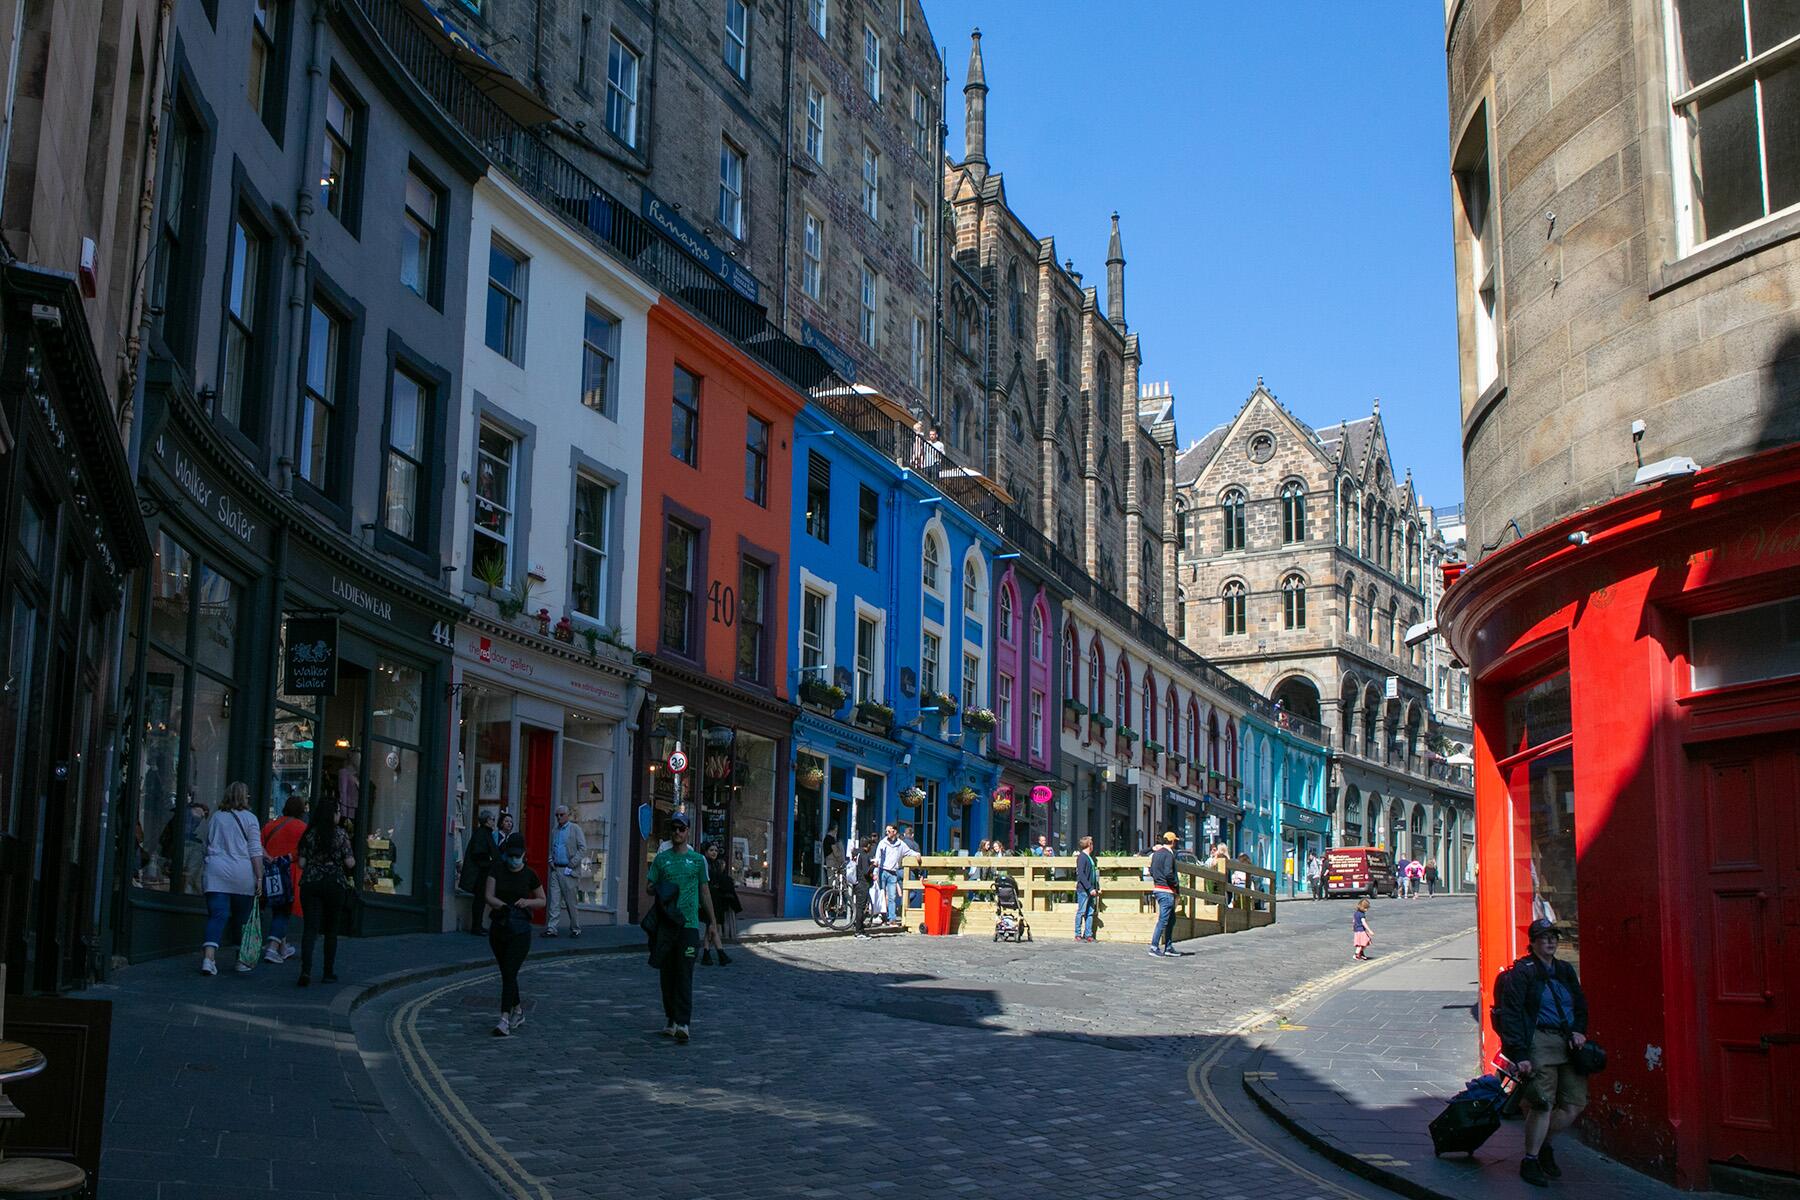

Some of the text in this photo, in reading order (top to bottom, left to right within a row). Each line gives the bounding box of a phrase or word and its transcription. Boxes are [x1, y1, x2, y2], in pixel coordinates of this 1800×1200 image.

[175, 450, 213, 507] Walker
[218, 495, 256, 542] Slater
[332, 576, 393, 622] LADIESWEAR
[707, 580, 734, 628] 40
[510, 656, 534, 676] gallery
[671, 757, 685, 770] 20
